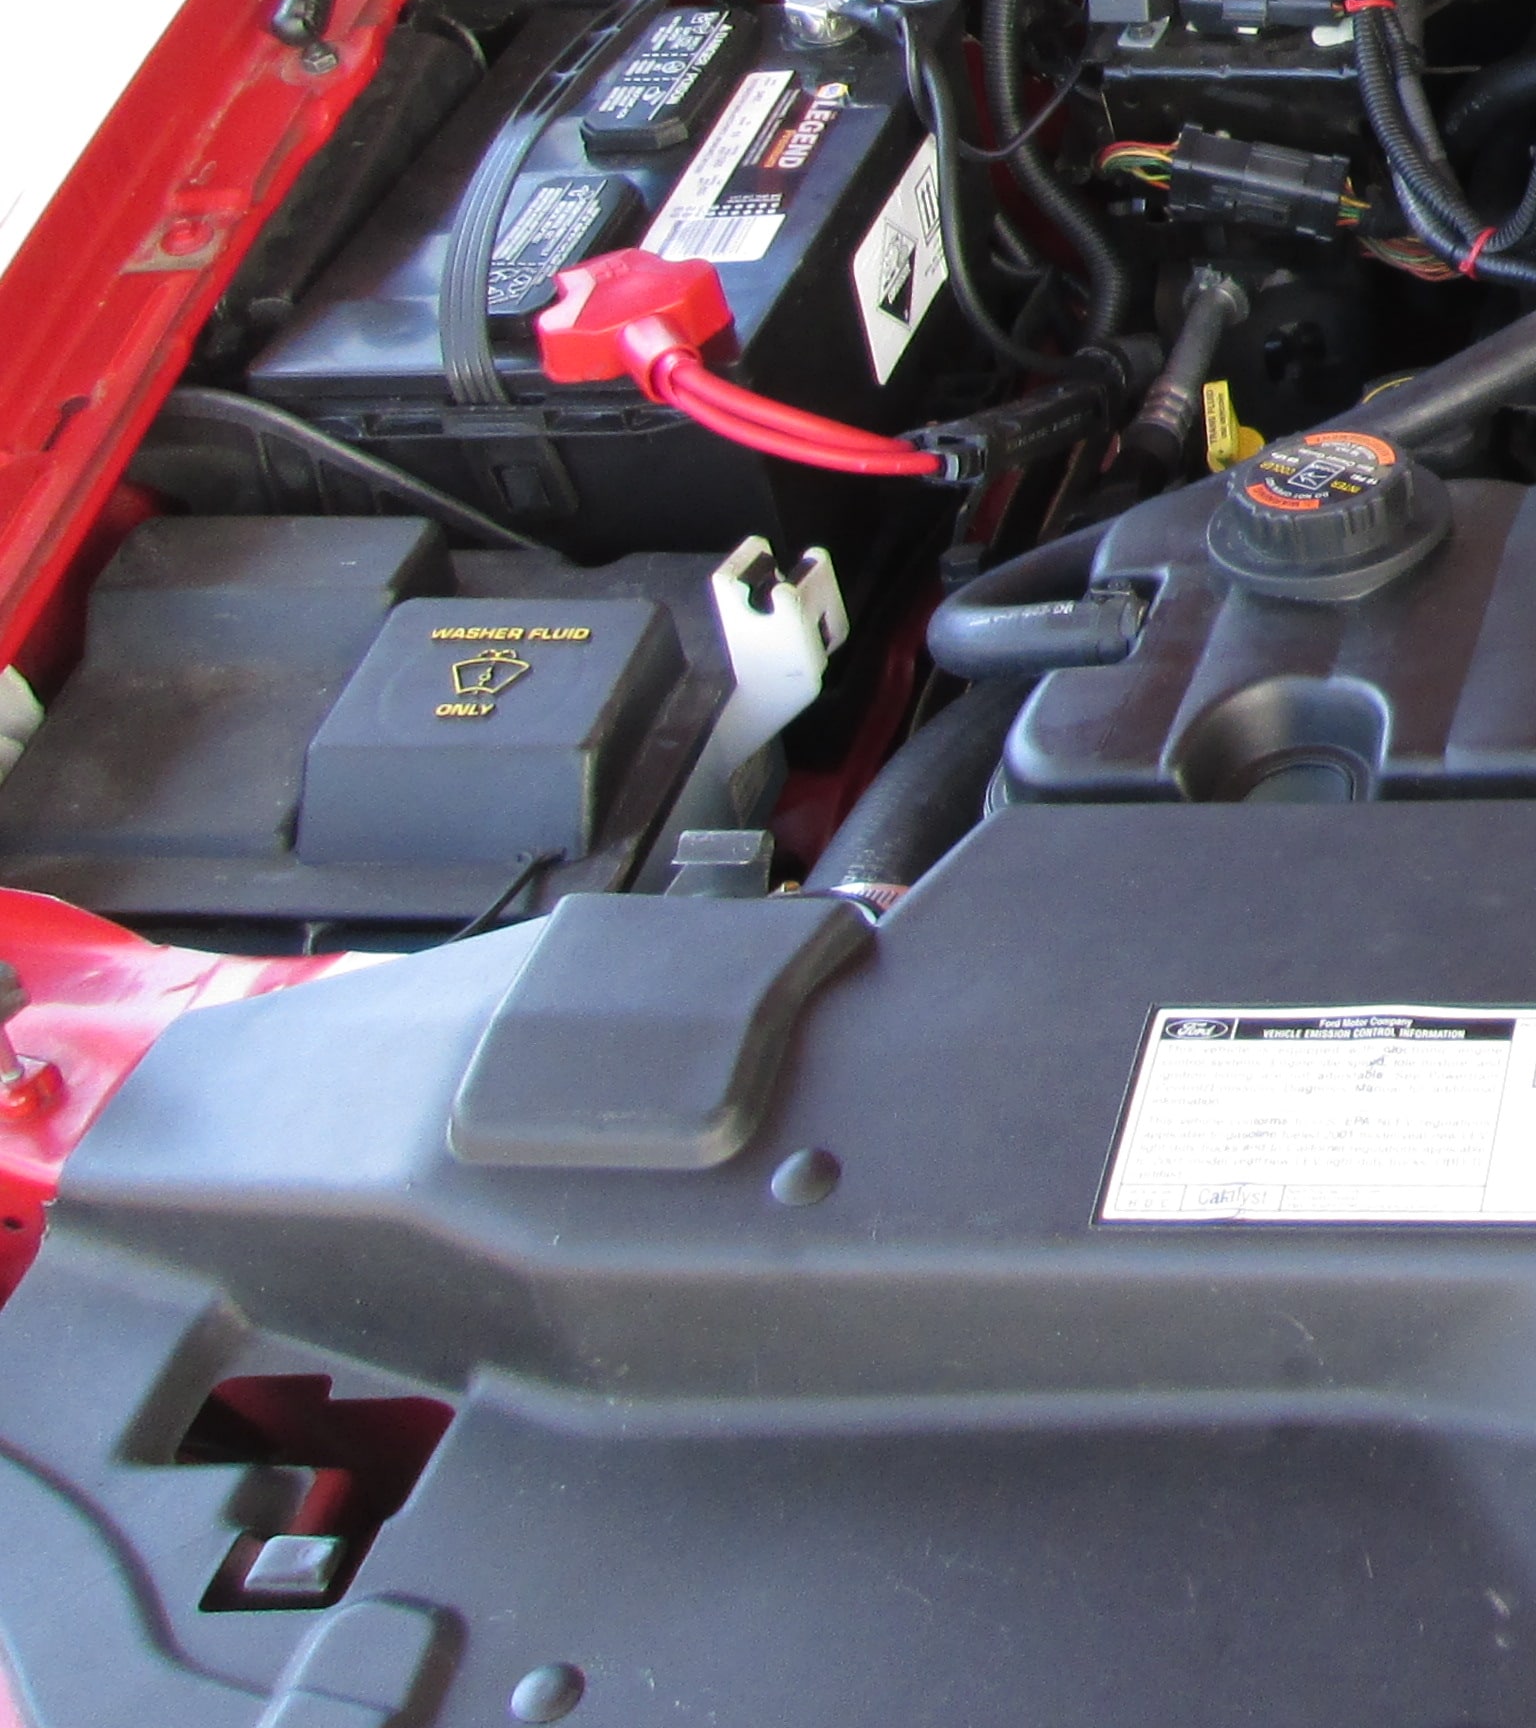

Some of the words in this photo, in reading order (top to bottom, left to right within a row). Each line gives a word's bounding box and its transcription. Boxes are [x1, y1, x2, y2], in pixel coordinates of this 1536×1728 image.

[778, 99, 842, 169] LEGEND
[430, 626, 524, 641] WASHER
[527, 626, 591, 641] FLUID
[434, 702, 496, 717] ONLY
[1319, 1017, 1341, 1029] Ford
[1342, 1017, 1369, 1029] Motor
[1369, 1016, 1413, 1030] Company
[1262, 1028, 1303, 1040] VEHICLE
[1304, 1028, 1351, 1040] EMISSION
[1352, 1027, 1396, 1039] CONTROL
[1399, 1027, 1466, 1040] INFORMATION
